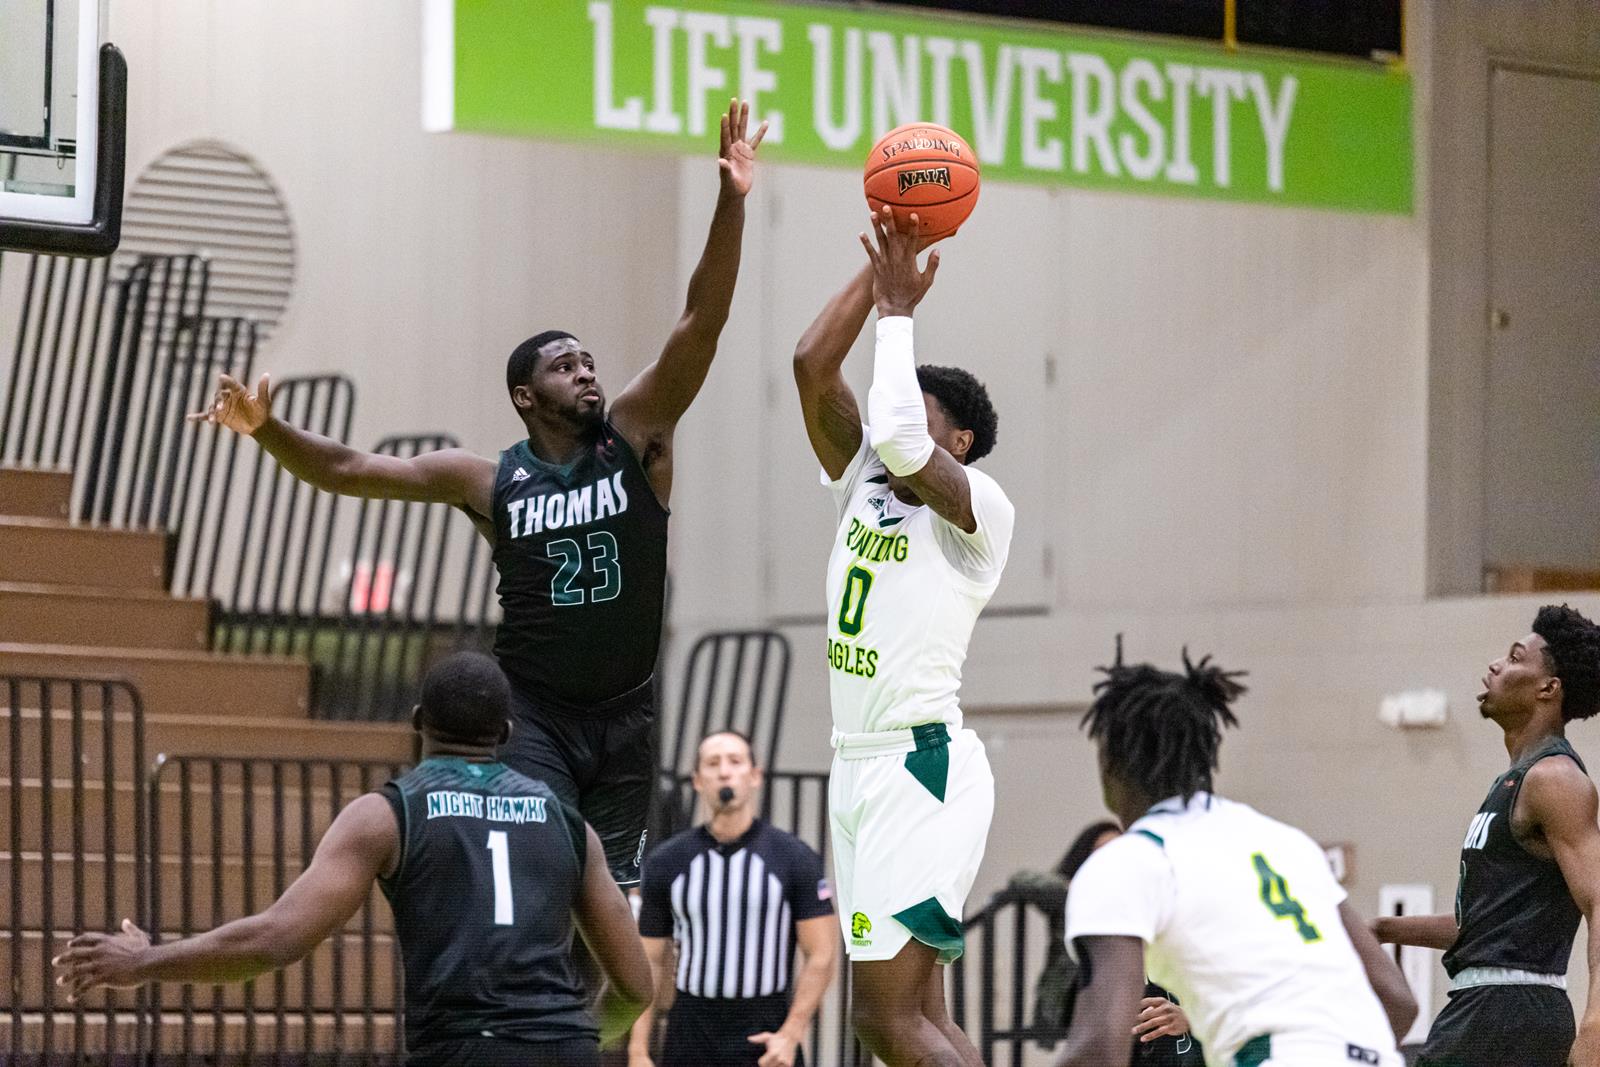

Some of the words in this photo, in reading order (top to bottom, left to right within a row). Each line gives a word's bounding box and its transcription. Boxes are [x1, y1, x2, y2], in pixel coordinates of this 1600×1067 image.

[589, 1, 783, 143] LIFE
[808, 24, 1297, 191] UNIVERSITY
[882, 139, 961, 162] SPALDING
[898, 167, 951, 196] NAIA
[507, 470, 628, 539] THOMAS
[546, 530, 622, 606] 23
[838, 563, 875, 637] 0
[827, 638, 879, 678] AGLES
[427, 790, 484, 820] NIGHT
[486, 796, 547, 824] HAWKS
[486, 829, 514, 925] 1
[1251, 851, 1323, 944] 4
